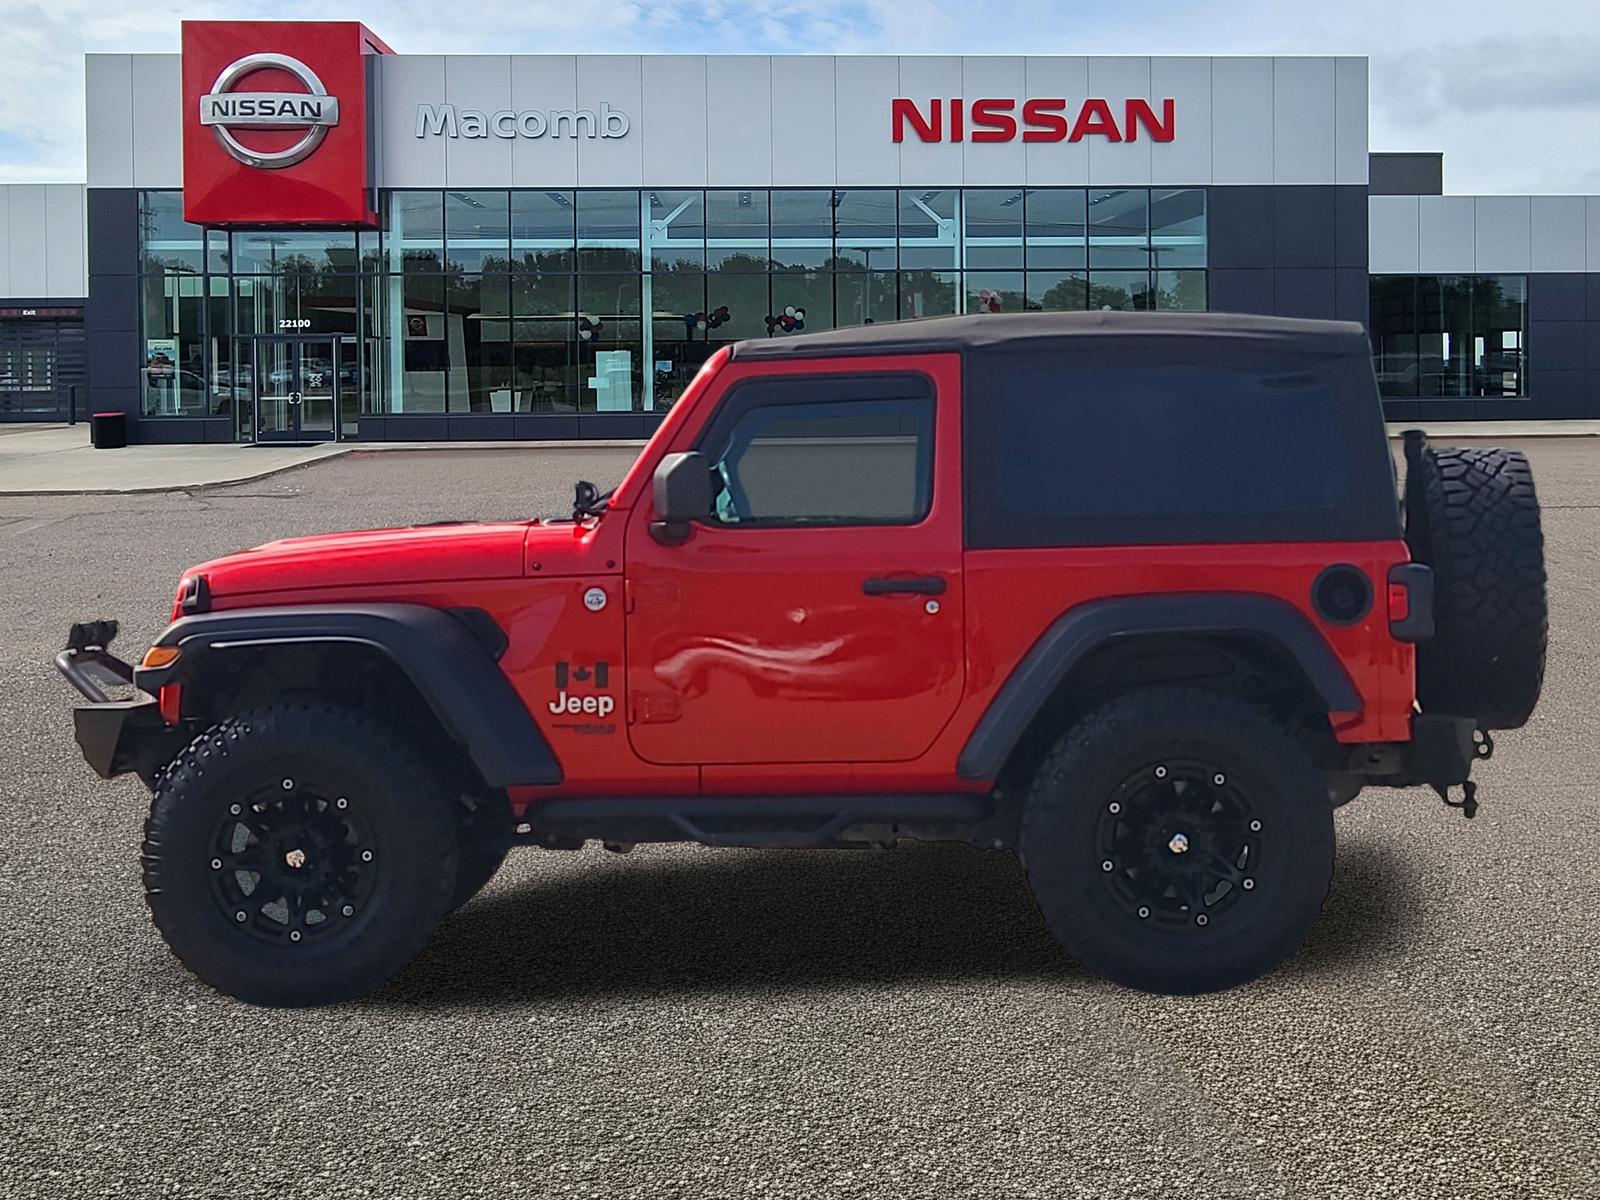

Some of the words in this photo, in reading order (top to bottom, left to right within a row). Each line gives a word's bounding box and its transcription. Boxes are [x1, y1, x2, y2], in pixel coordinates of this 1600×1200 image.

[211, 100, 322, 117] NISSAN
[415, 102, 630, 139] Macomb
[892, 98, 1176, 143] NISSAN
[279, 319, 311, 328] 22100
[548, 691, 615, 718] Jeep
